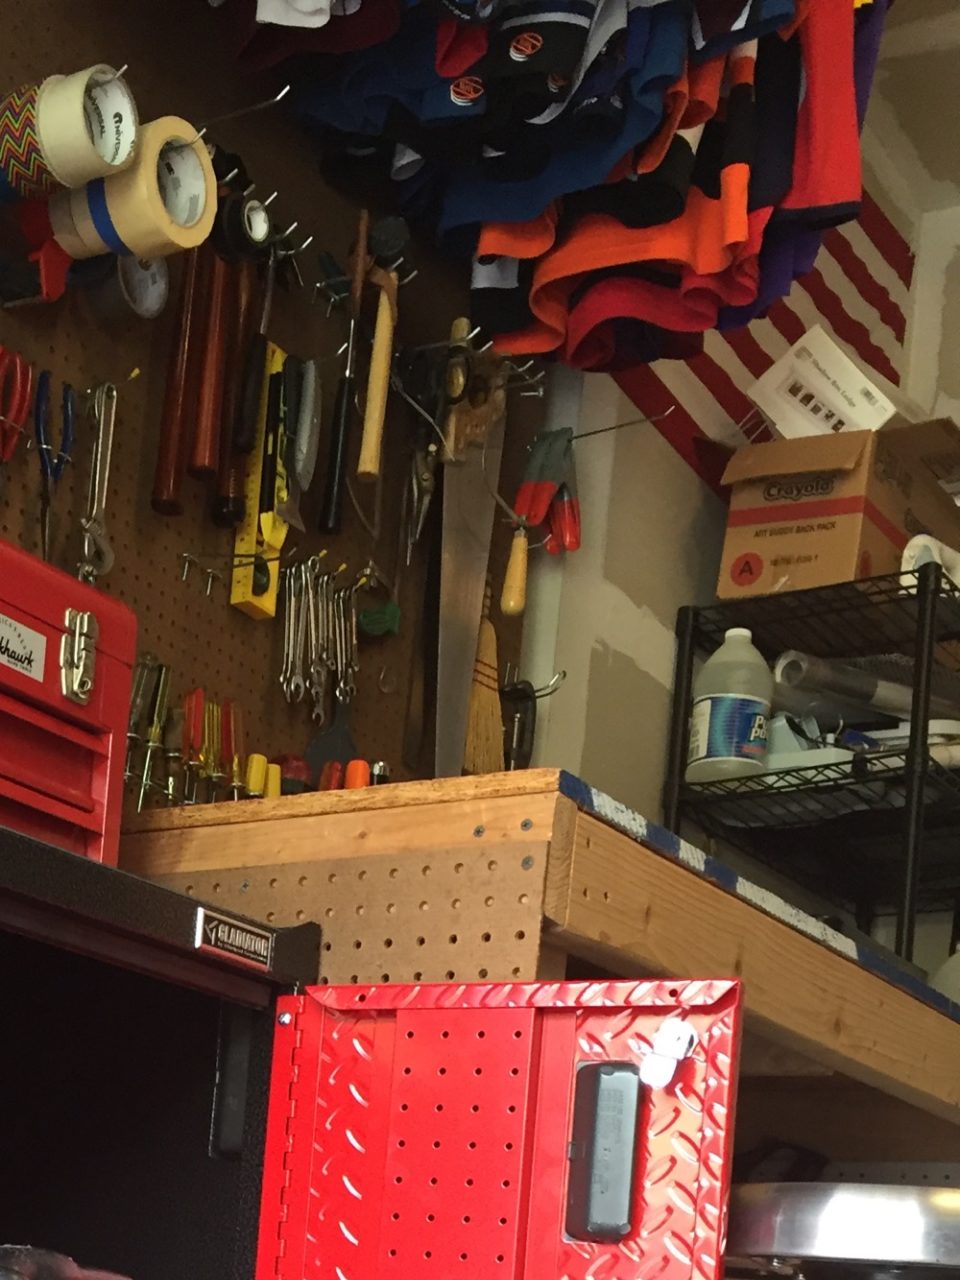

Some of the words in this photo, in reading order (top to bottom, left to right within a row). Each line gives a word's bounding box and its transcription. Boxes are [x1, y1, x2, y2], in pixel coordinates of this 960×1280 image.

[764, 478, 835, 501] Crayola
[739, 561, 754, 576] A
[218, 923, 269, 956] GLADIATOR
